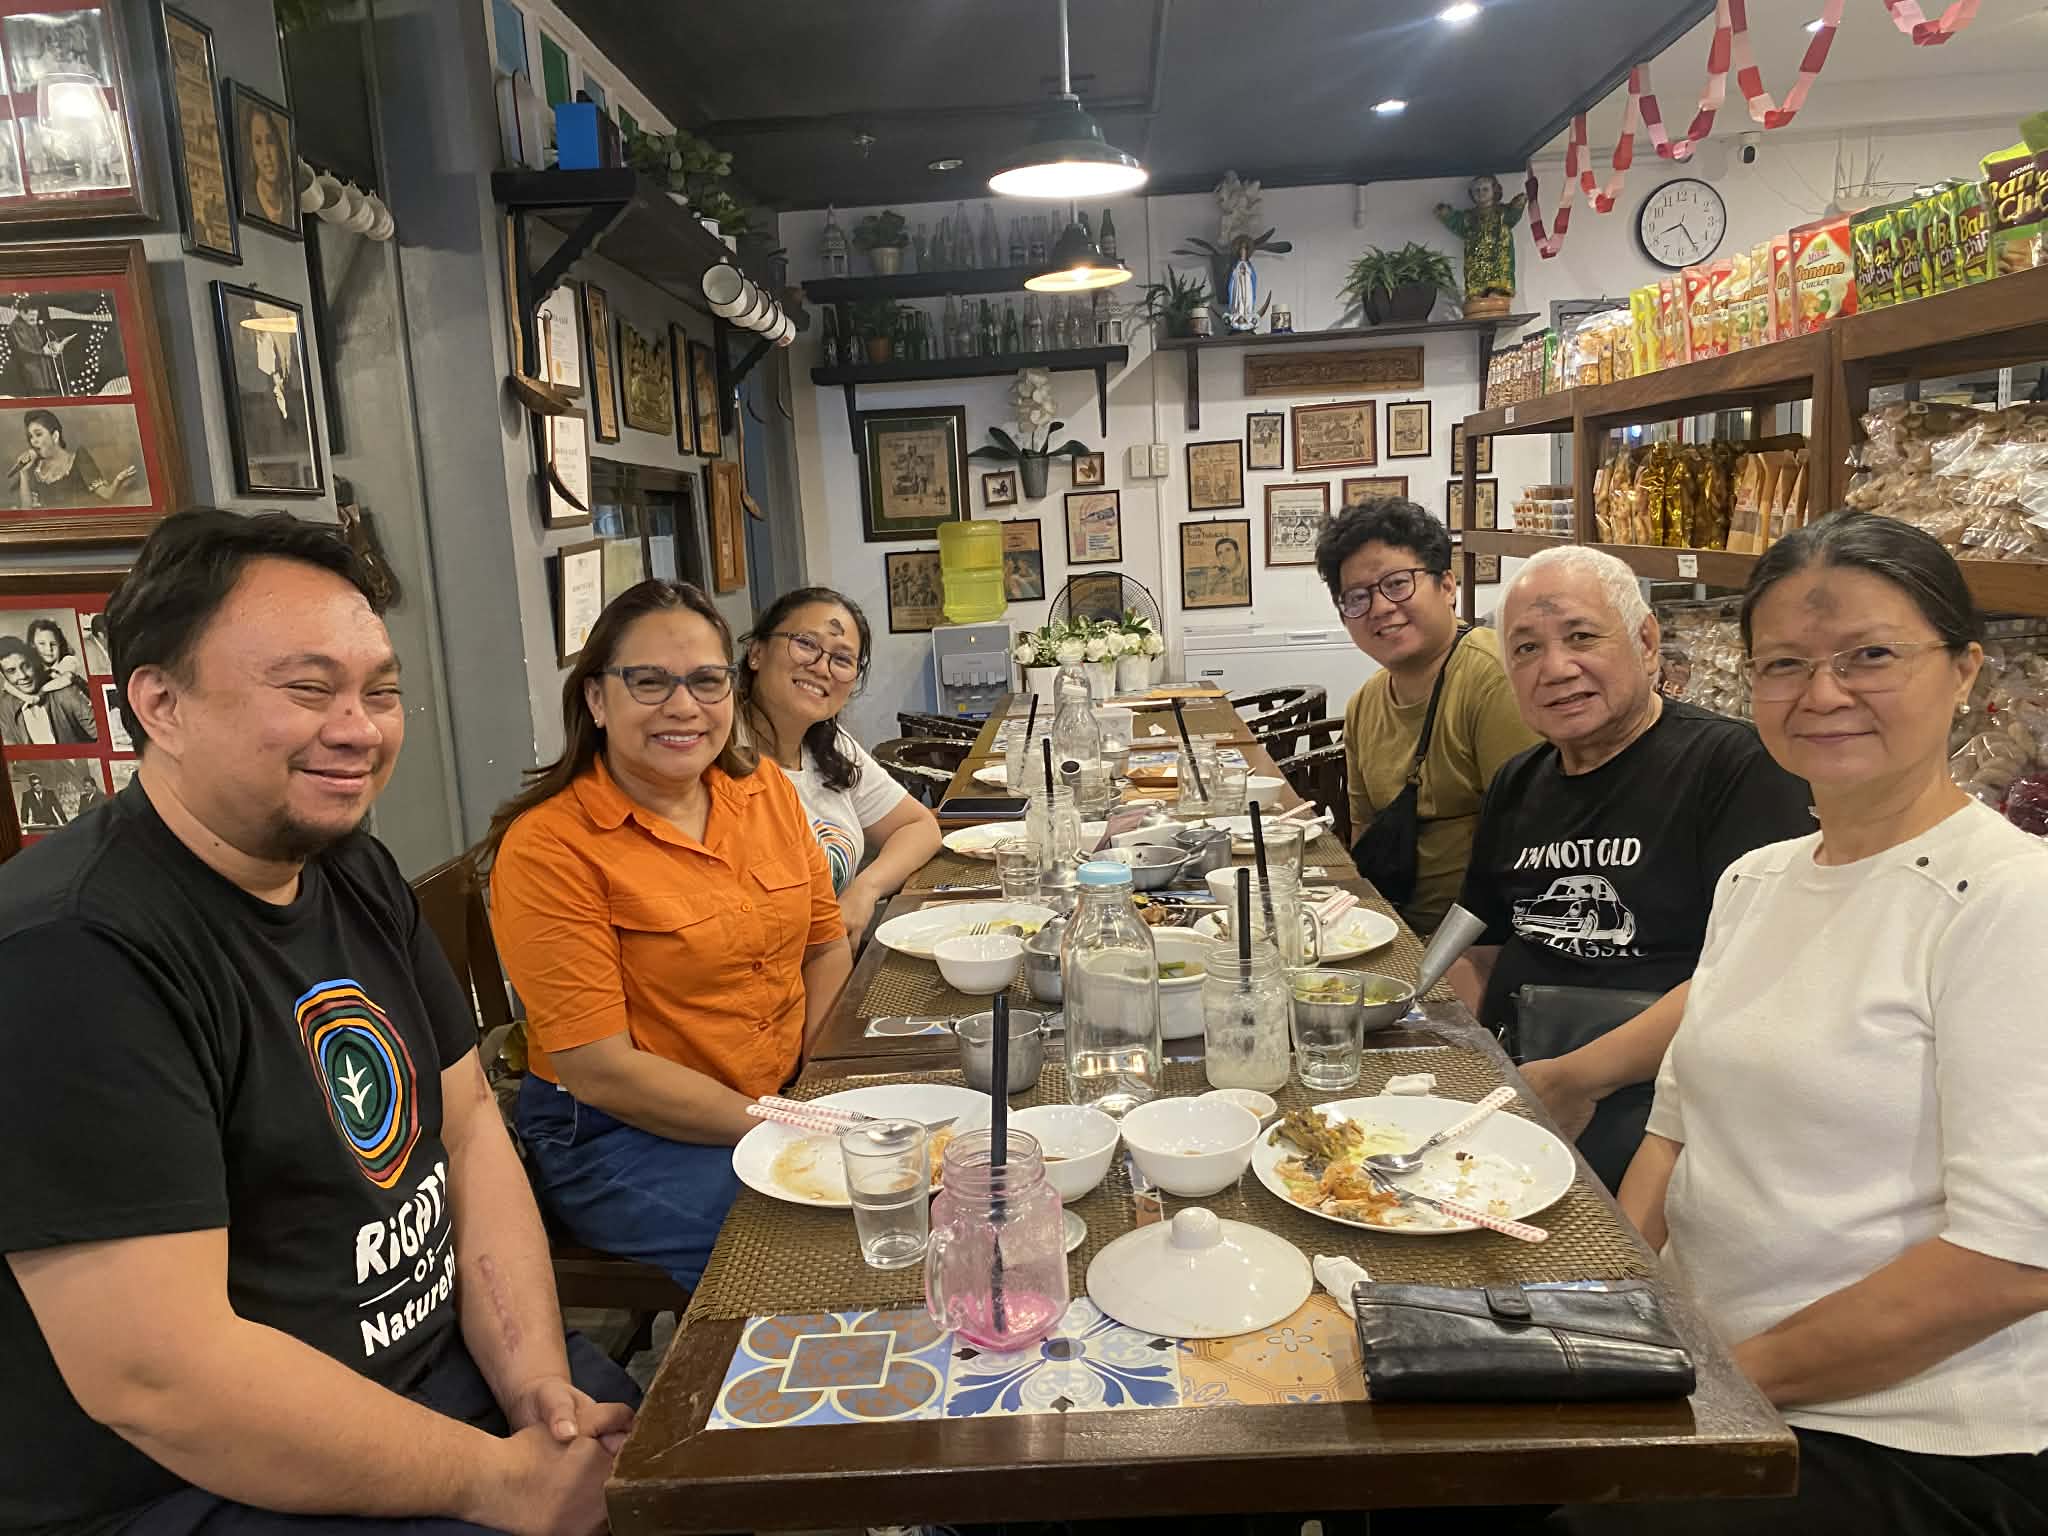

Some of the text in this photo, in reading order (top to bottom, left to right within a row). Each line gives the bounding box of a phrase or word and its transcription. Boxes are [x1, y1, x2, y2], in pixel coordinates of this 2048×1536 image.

[1664, 195, 1672, 207] 11
[1676, 191, 1687, 201] 12
[1654, 207, 1664, 219] 10
[1794, 261, 1845, 282] Banana
[1545, 839, 1594, 869] NOT
[1596, 837, 1641, 867] OLD
[414, 1248, 436, 1283] OF
